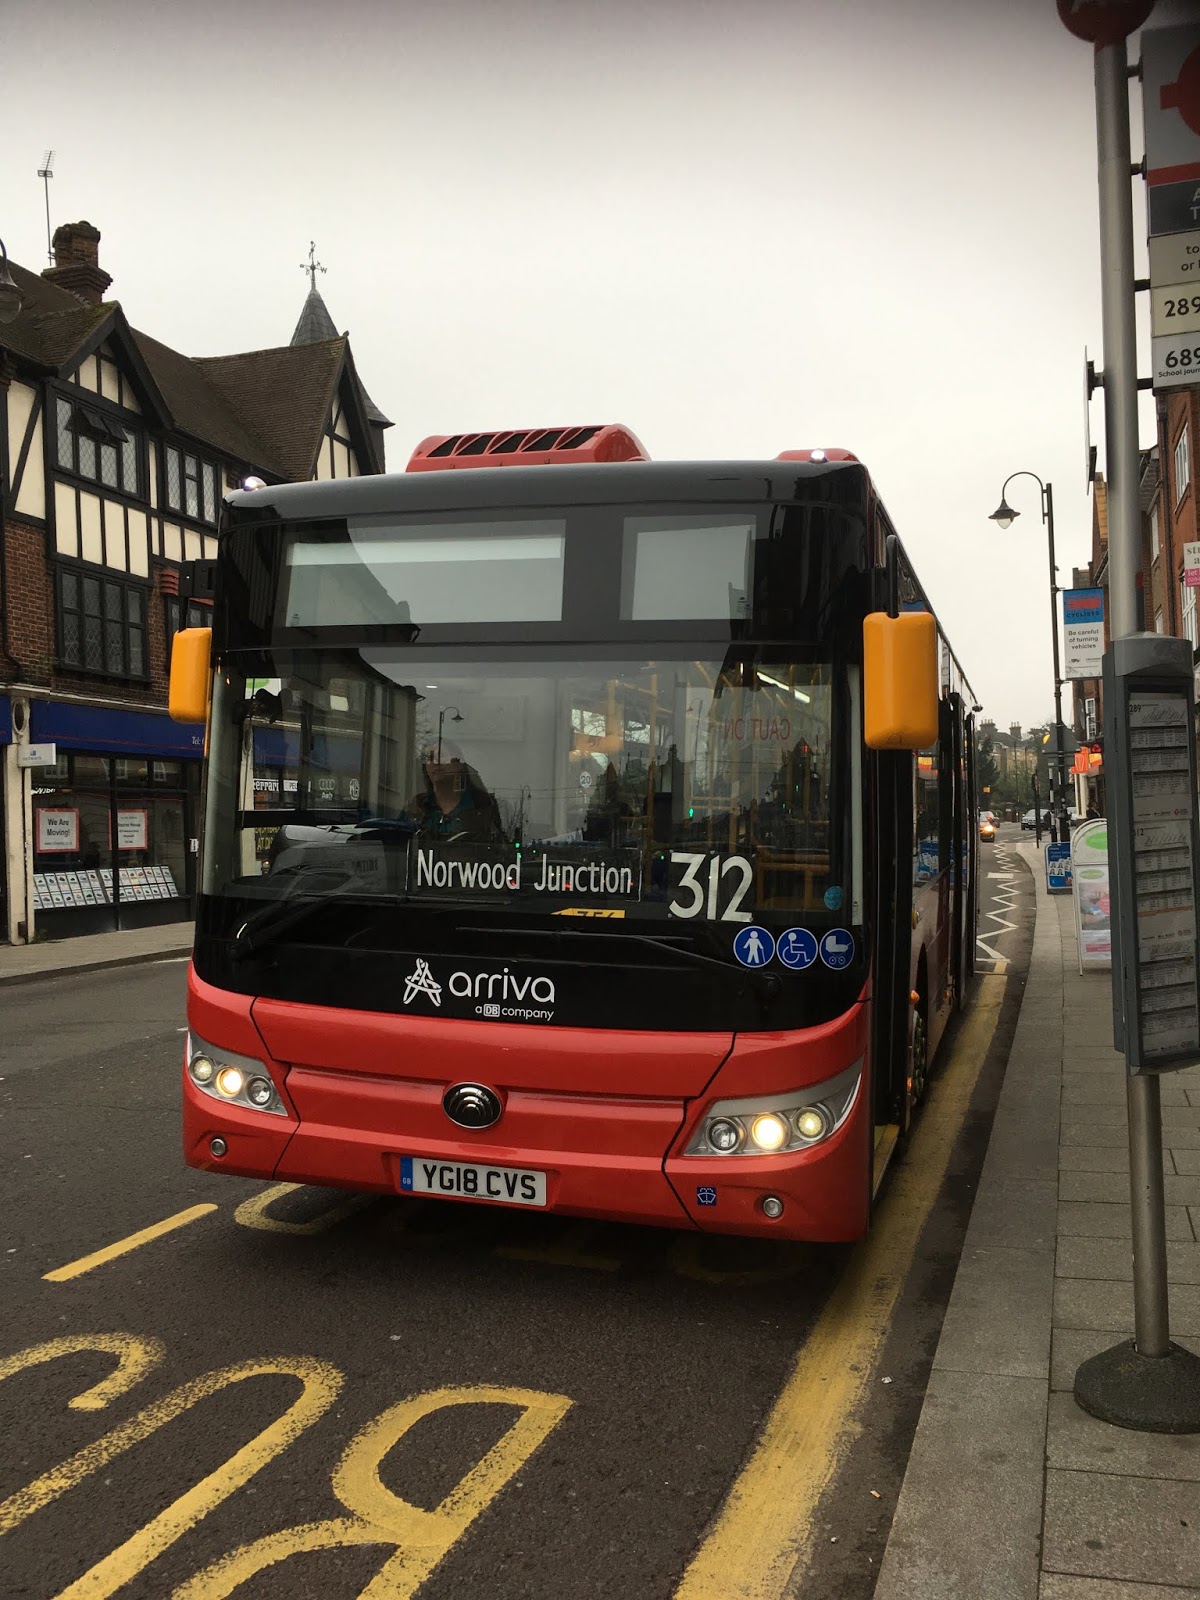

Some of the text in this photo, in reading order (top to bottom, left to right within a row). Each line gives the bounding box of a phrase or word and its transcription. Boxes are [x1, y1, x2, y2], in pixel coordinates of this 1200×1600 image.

[1158, 368, 1183, 378] School
[1066, 611, 1100, 619] CYCLISTS
[1077, 628, 1099, 636] careful
[47, 818, 70, 826] We Are
[417, 849, 631, 894] Norwood Junction
[668, 851, 753, 923] 312
[448, 967, 555, 1004] arriva
[484, 1004, 499, 1016] DB
[501, 1007, 555, 1022] company
[423, 1164, 536, 1200] YG18 CVS
